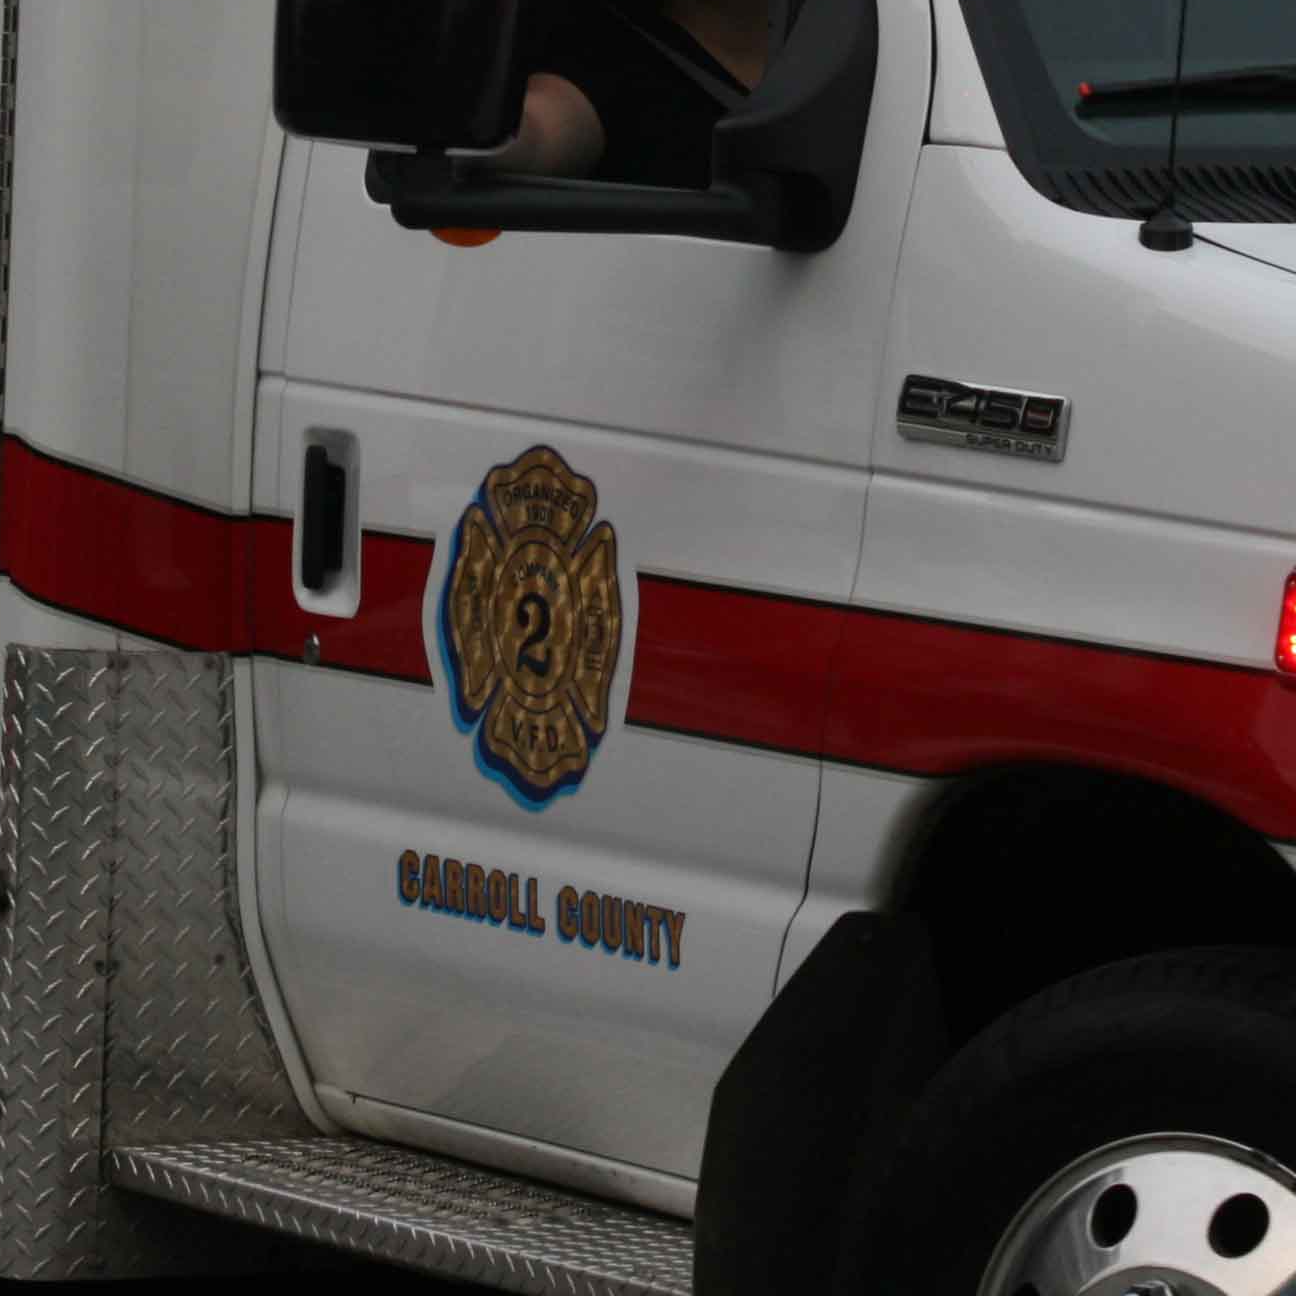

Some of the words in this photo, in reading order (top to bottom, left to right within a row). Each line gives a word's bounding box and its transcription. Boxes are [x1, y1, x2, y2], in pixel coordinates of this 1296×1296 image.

[516, 592, 551, 677] 2
[397, 848, 547, 938] CARROLL
[556, 884, 687, 971] COUNTY
